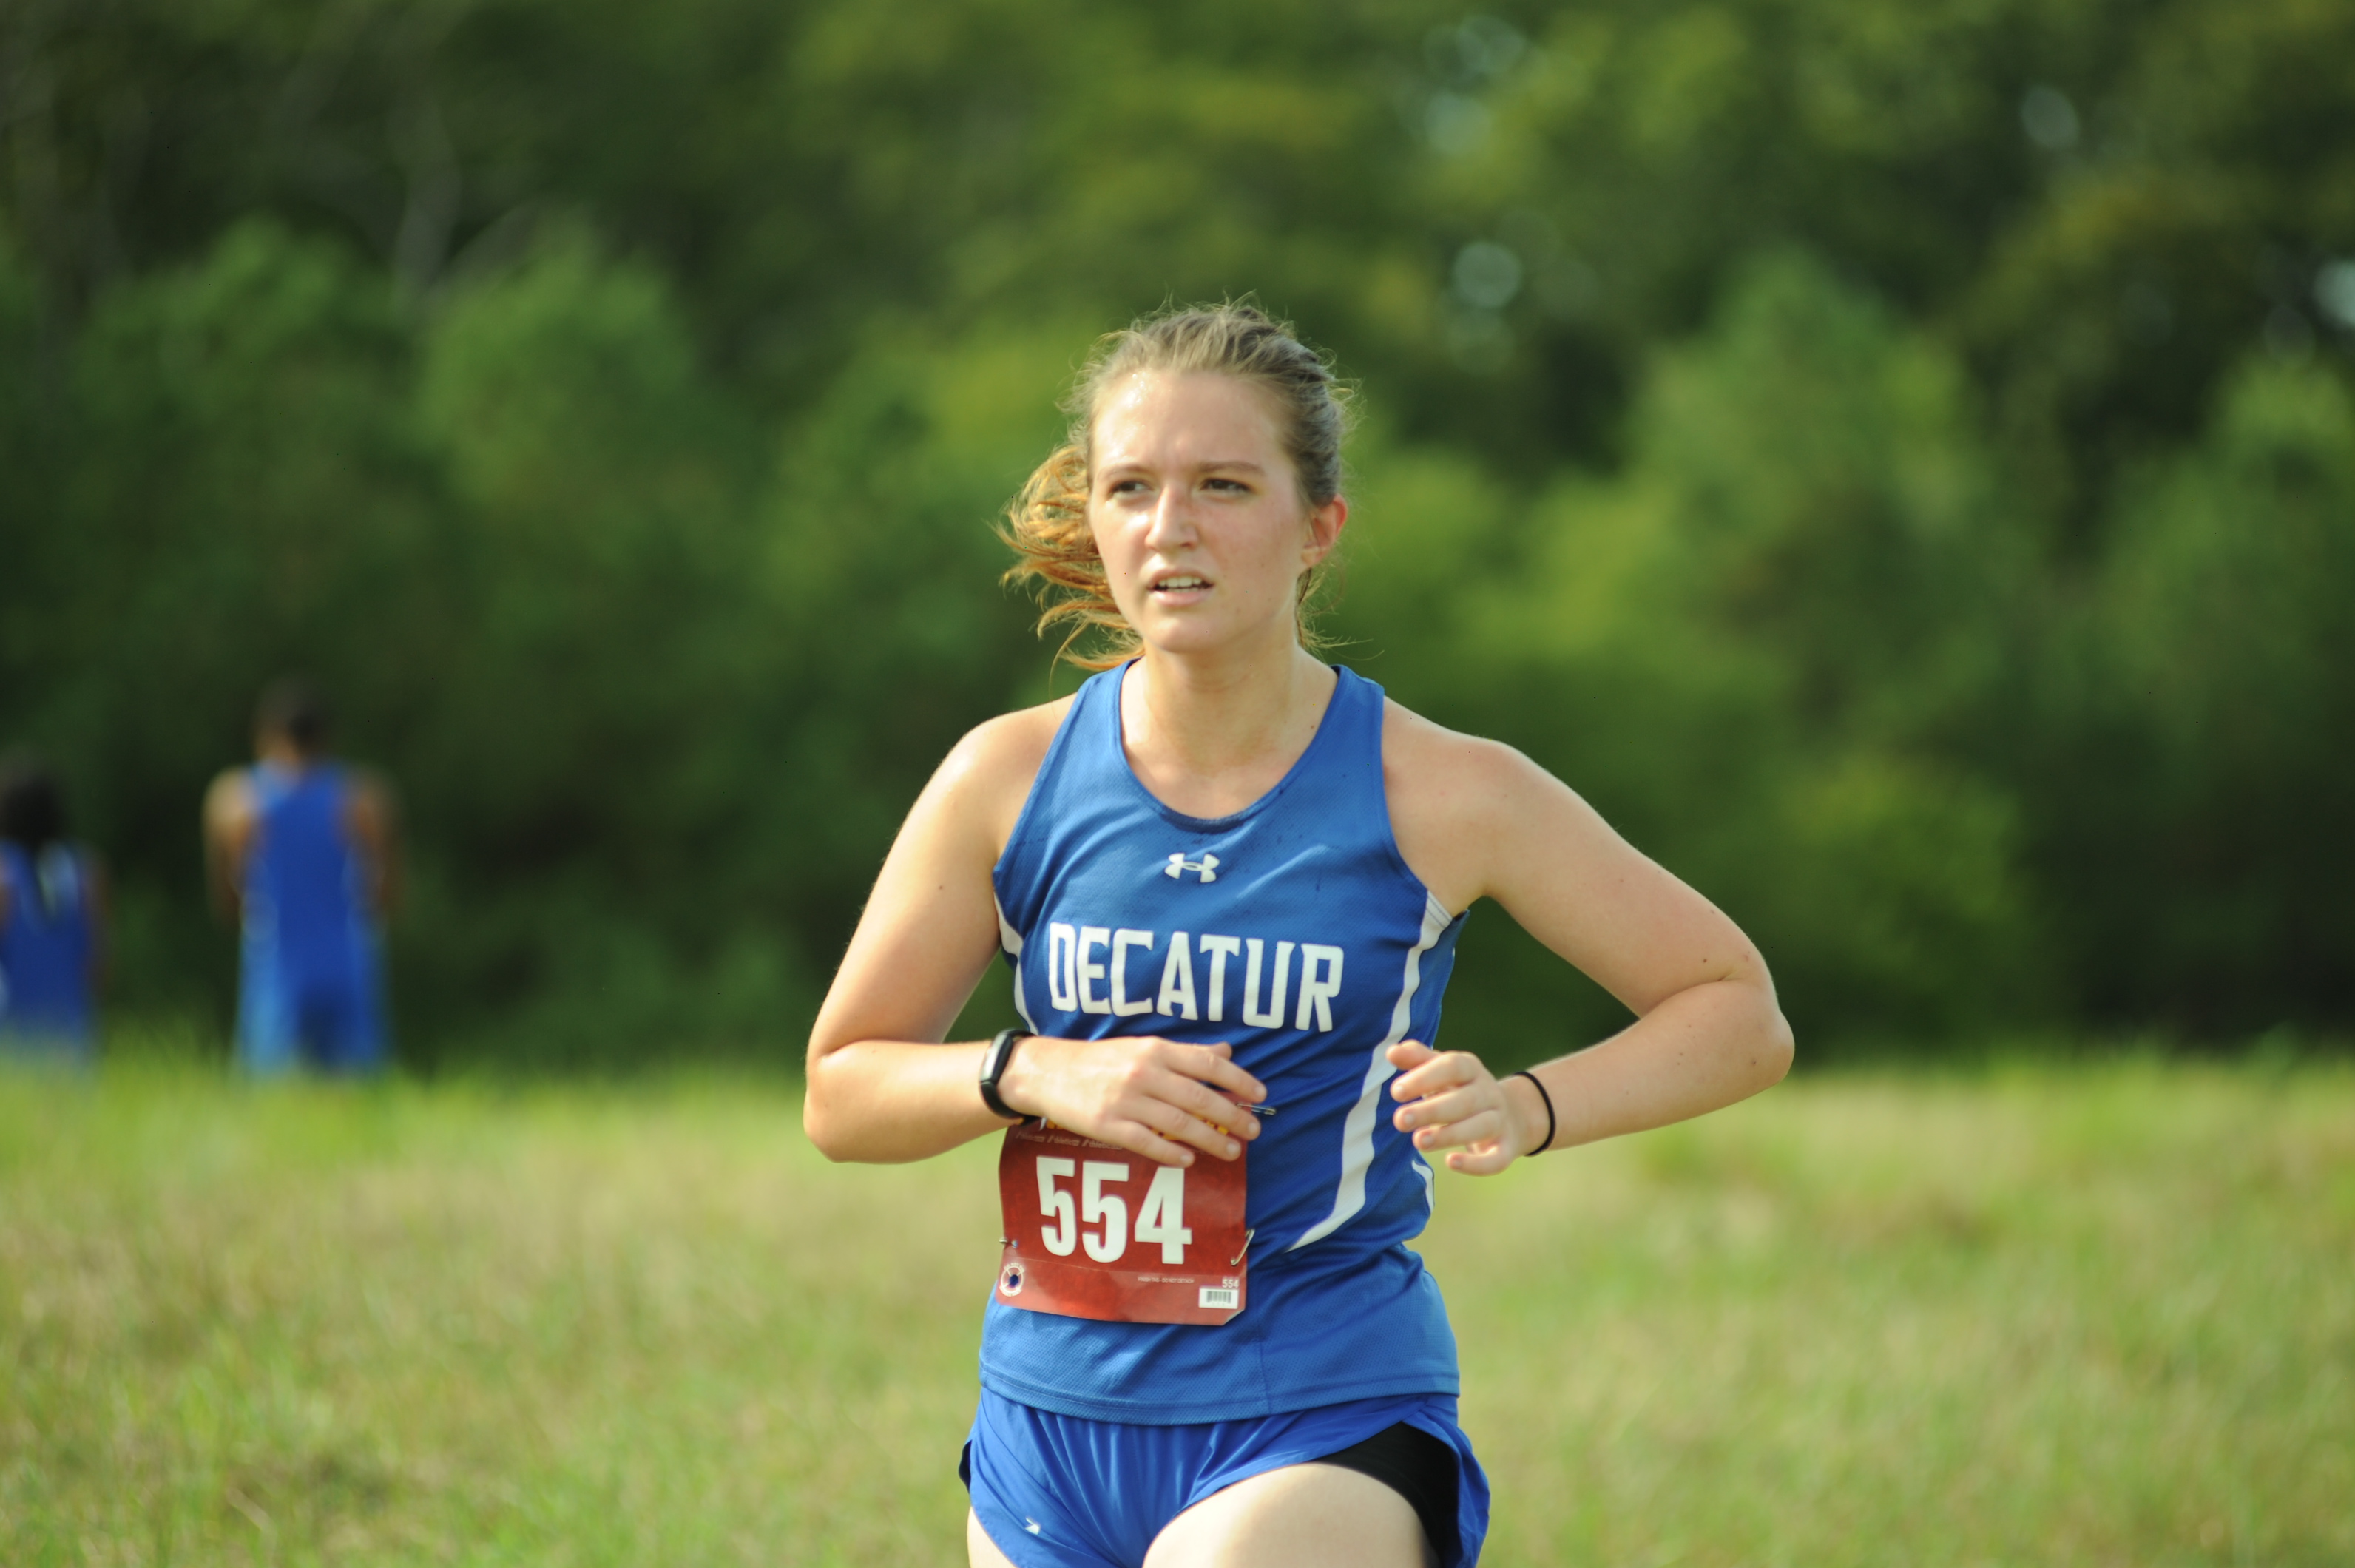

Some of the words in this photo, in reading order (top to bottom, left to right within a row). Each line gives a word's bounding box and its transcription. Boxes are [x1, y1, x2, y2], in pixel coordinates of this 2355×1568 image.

[1049, 922, 1344, 1033] DECATUR
[1036, 1155, 1192, 1265] 554
[1222, 1278, 1239, 1288] 554
